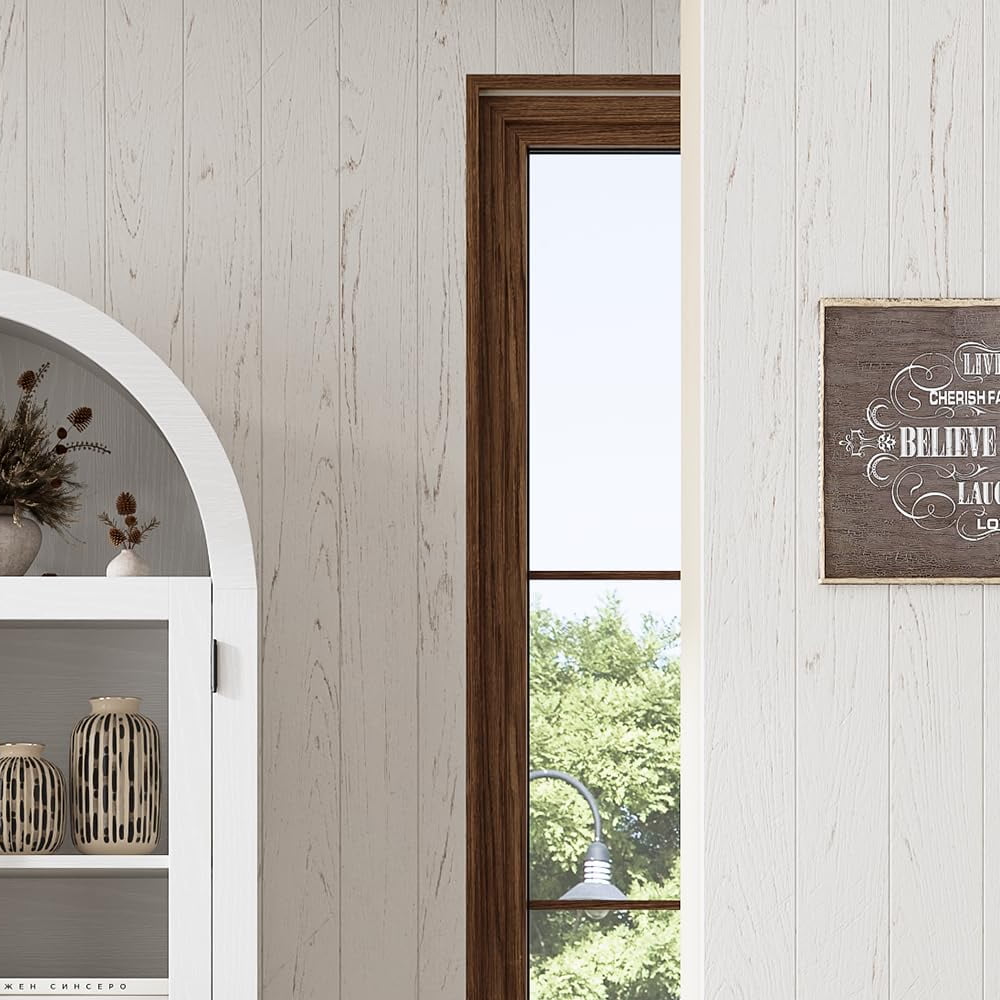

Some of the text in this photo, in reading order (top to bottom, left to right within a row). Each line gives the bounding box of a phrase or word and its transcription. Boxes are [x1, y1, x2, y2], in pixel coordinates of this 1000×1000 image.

[929, 390, 986, 405] CHERISH
[899, 426, 997, 458] BELIEVE
[50, 983, 127, 991] СИНСЕРО
